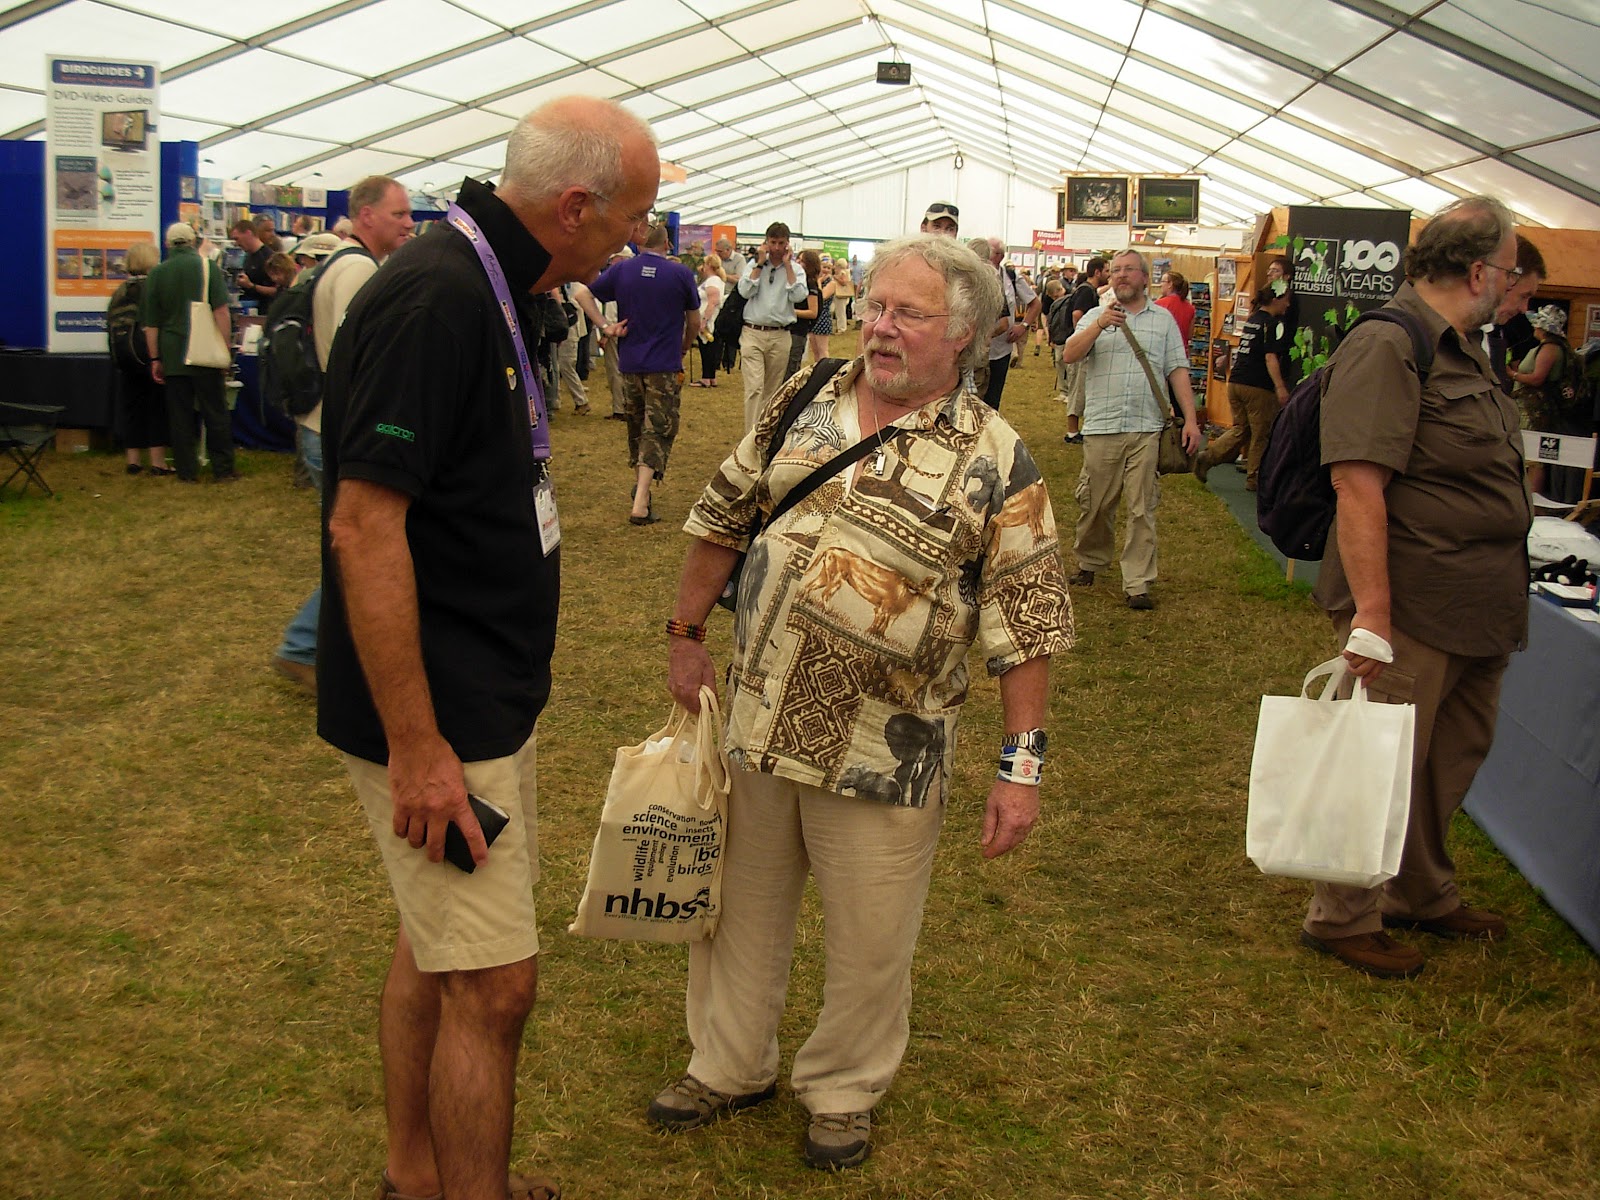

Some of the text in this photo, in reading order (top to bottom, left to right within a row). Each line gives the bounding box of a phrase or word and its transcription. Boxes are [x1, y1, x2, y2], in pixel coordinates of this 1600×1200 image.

[61, 64, 132, 77] BIRDGUIDES
[54, 90, 153, 105] DVD-Video Guides
[1037, 231, 1062, 239] Massiv
[1340, 240, 1400, 272] 100
[1293, 281, 1333, 293] TRUSTS
[1341, 272, 1394, 293] YEARS
[58, 317, 108, 328] www.birdg
[632, 810, 678, 831] science
[648, 803, 696, 823] conservation
[622, 824, 717, 843] environment
[685, 825, 714, 834] insects
[633, 839, 650, 881] wildlife
[646, 839, 659, 877] equipment
[666, 845, 680, 882] evolution
[697, 846, 721, 862] bo
[677, 862, 713, 875] birds
[604, 887, 698, 919] nhbs
